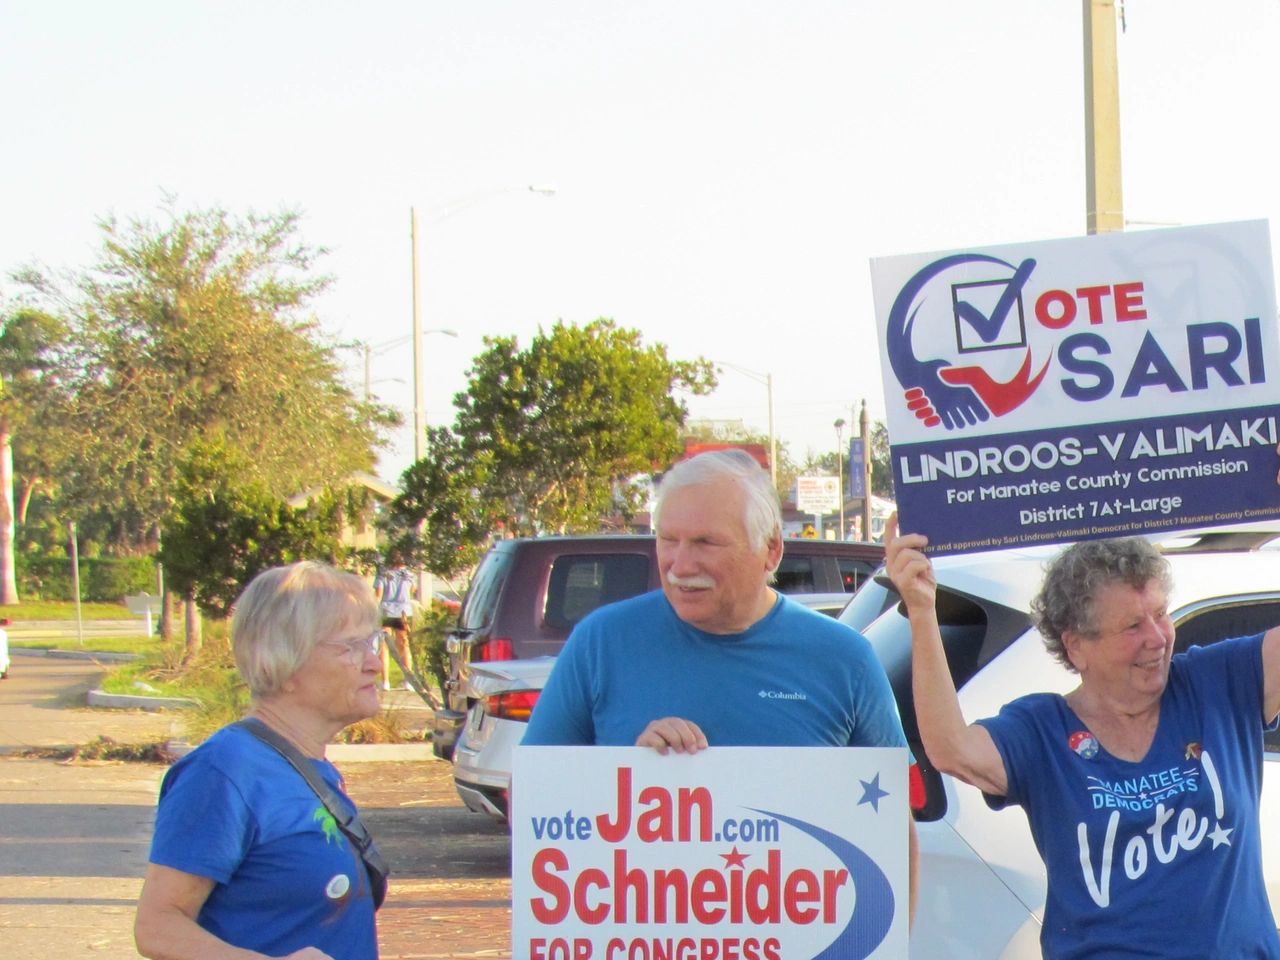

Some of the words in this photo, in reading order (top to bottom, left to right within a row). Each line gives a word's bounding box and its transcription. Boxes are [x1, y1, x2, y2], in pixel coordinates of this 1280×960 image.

[1058, 317, 1266, 402] SARI
[900, 417, 1278, 484] LINDROOS-VALIMAKI
[946, 488, 976, 504] For
[980, 479, 1061, 501] Manatee
[1066, 470, 1132, 492] County
[1137, 458, 1249, 483] Commission
[953, 539, 991, 550] approved
[1091, 522, 1130, 534] Democrat
[1144, 518, 1174, 528] District
[1180, 513, 1214, 525] Manatee
[1215, 509, 1243, 521] County
[1019, 503, 1084, 525] District
[767, 690, 807, 701] Columbia
[1092, 778, 1198, 812] DEMOCRATS
[529, 846, 849, 926] Schneider
